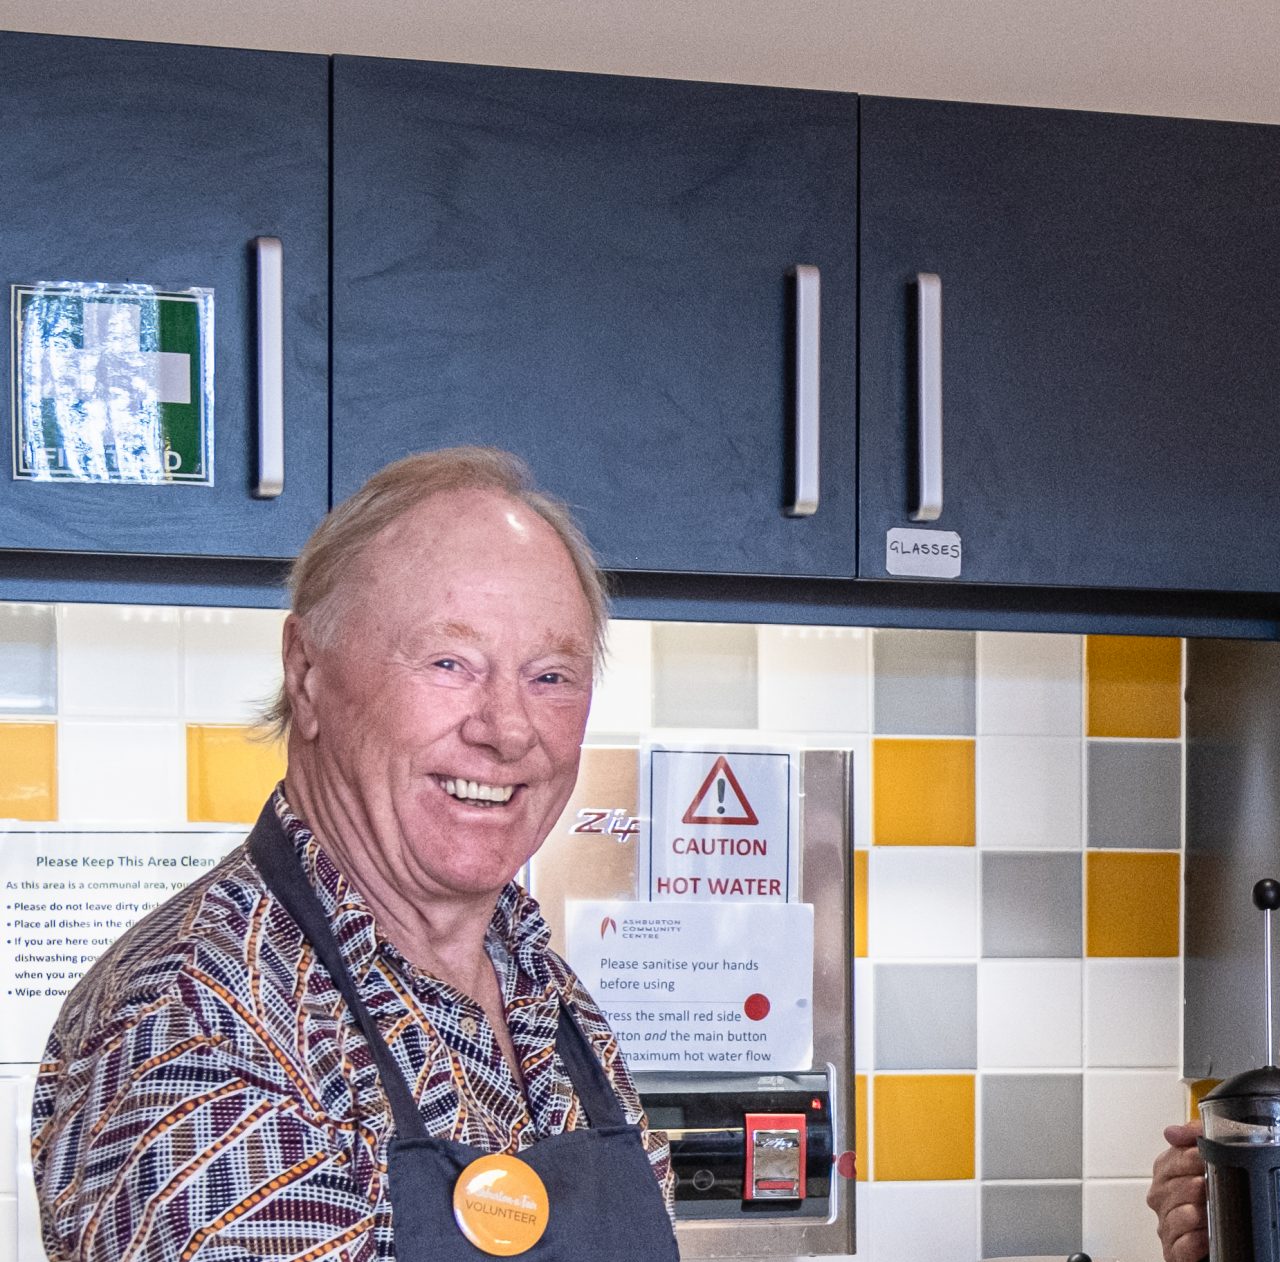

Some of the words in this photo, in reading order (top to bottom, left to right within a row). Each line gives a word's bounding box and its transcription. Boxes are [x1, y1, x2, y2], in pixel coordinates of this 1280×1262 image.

[889, 540, 960, 558] GLASSES
[672, 837, 767, 856] CAUTION
[36, 856, 79, 867] Please
[82, 857, 114, 869] Keep
[118, 856, 144, 867] This
[147, 857, 177, 867] Area
[181, 856, 215, 867] Clean
[6, 881, 18, 890] As
[21, 880, 40, 890] this
[42, 882, 65, 890] area
[68, 880, 76, 890] is
[79, 882, 85, 890] a
[87, 880, 141, 890] communal
[143, 882, 168, 891] area,
[657, 877, 701, 895] HOT
[708, 878, 781, 896] WATER
[14, 902, 47, 911] Please
[50, 902, 63, 911] do
[66, 903, 82, 911] not
[86, 902, 113, 911] leave
[115, 902, 139, 912] dirty
[14, 919, 41, 929] Place
[44, 919, 56, 929] all
[59, 919, 91, 929] dishes
[93, 919, 103, 928] in
[106, 919, 122, 928] the
[14, 937, 22, 946] If
[24, 938, 43, 948] you
[46, 938, 63, 946] are
[65, 937, 89, 946] here
[14, 953, 78, 964] dishwashing
[600, 958, 639, 970] Please
[642, 958, 688, 970] sanitise
[691, 960, 720, 973] your
[722, 959, 759, 971] hands
[14, 970, 43, 979] when
[46, 971, 65, 980] you
[600, 978, 640, 990] before
[643, 978, 676, 992] using
[15, 987, 42, 997] Wipe
[636, 1010, 655, 1021] the
[658, 1010, 690, 1021] small
[693, 1010, 713, 1021] red
[716, 1010, 742, 1022] side
[616, 1031, 641, 1041] tton
[644, 1029, 667, 1041] and
[670, 1030, 690, 1041] the
[693, 1030, 724, 1041] main
[727, 1030, 767, 1042] button
[622, 1051, 680, 1061] maximum
[684, 1050, 704, 1061] hot
[708, 1051, 743, 1061] water
[746, 1050, 772, 1061] flow
[464, 1199, 537, 1225] VOLUNTEER
